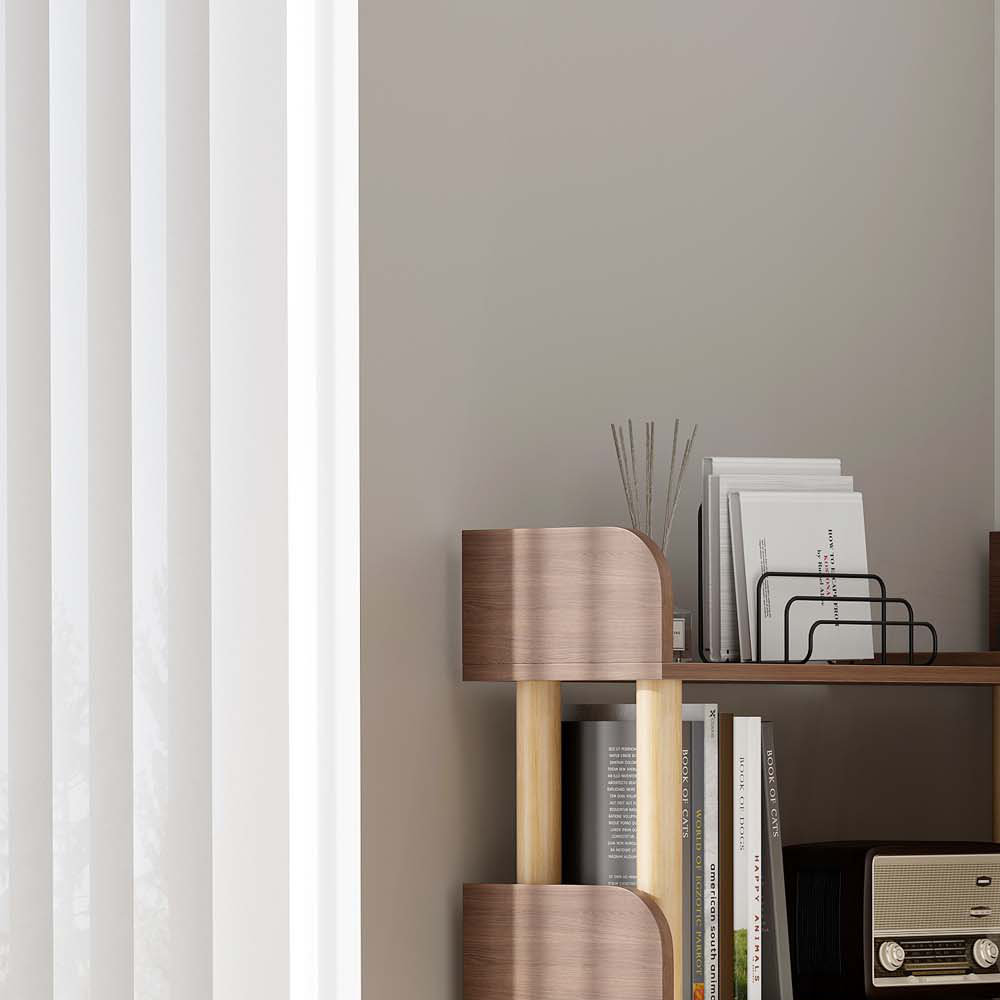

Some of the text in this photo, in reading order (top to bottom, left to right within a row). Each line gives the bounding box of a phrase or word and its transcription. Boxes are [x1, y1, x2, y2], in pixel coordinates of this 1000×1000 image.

[682, 787, 689, 804] OF
[766, 750, 779, 838] BOOK OF CATS
[695, 808, 703, 851] WORLD
[695, 855, 702, 872] OF
